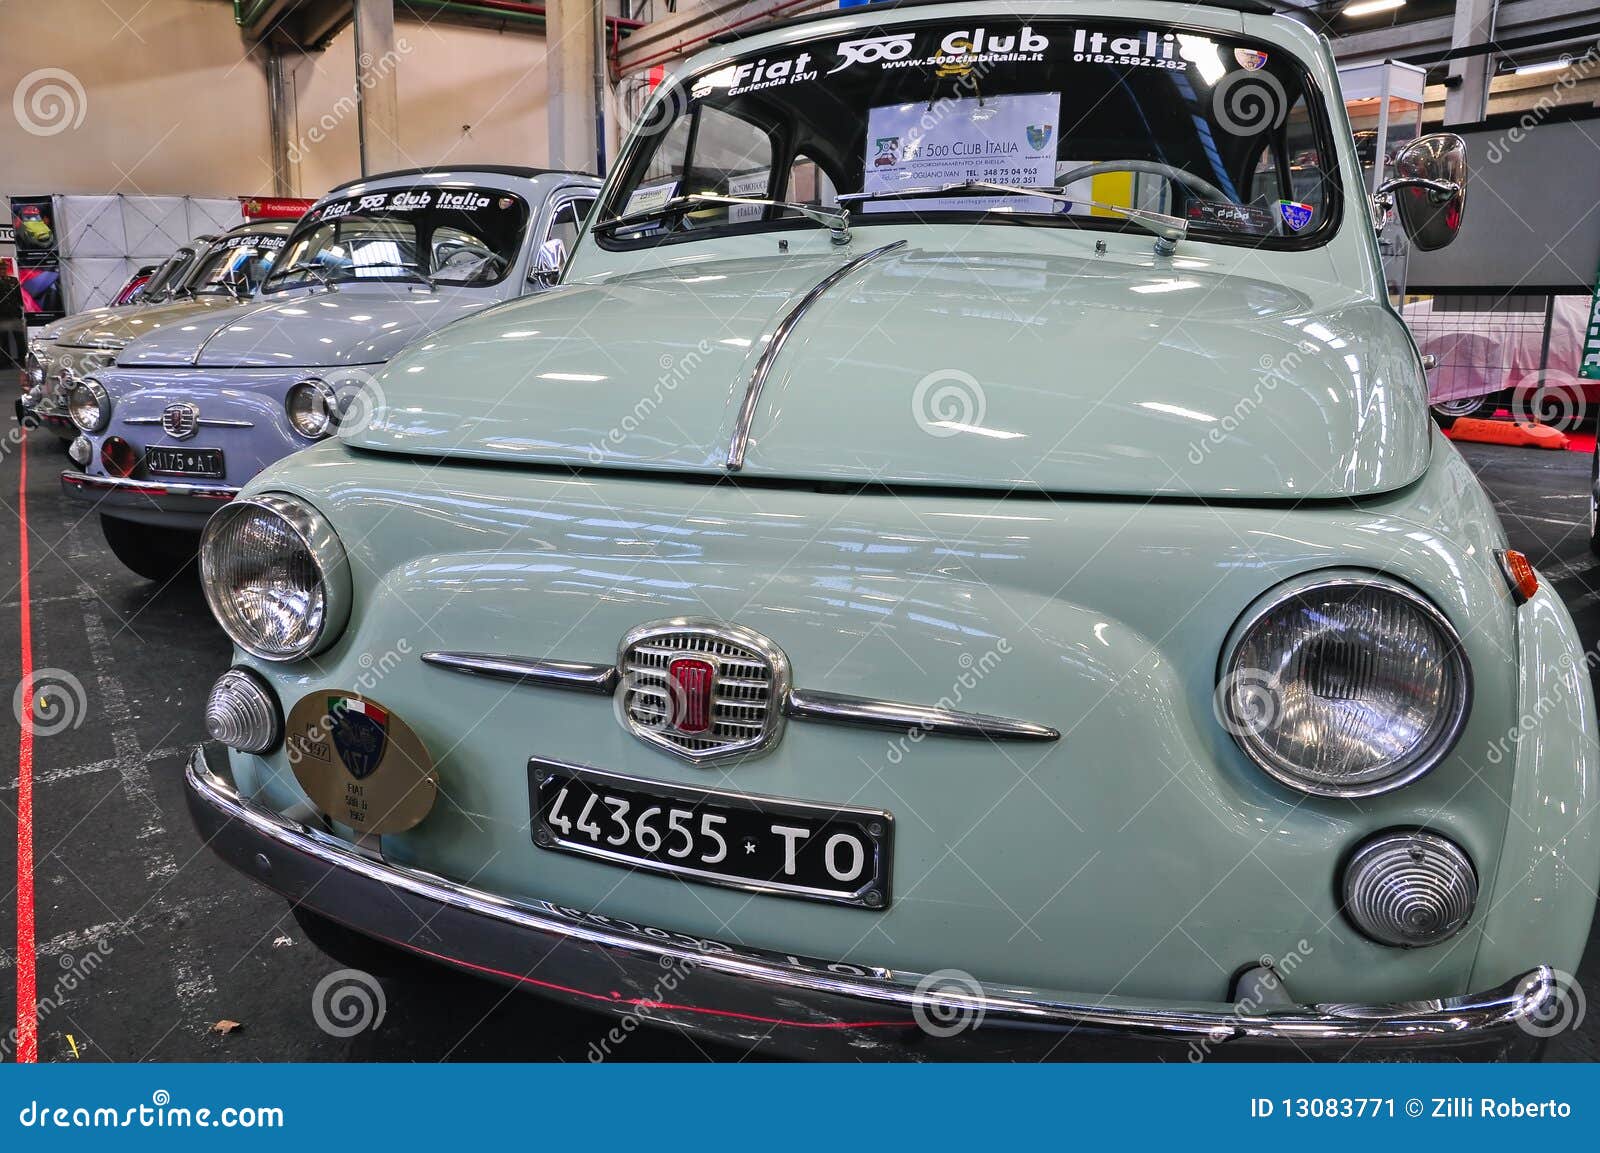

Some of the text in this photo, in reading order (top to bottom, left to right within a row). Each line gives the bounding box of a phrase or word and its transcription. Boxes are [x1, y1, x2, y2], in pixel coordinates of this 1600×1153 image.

[729, 27, 1178, 89] Fiat 500 Club Itali
[1073, 54, 1187, 71] 0182.582.282
[791, 70, 818, 85] (SV)
[926, 143, 949, 157] 500
[953, 141, 981, 155] CLUB
[985, 140, 1019, 155] ITALIA
[944, 170, 960, 178] IVAN
[966, 169, 979, 177] TEL.
[999, 168, 1009, 176] 75
[1024, 167, 1038, 175] 963
[1011, 176, 1021, 184] 62
[1023, 176, 1036, 184] 351
[353, 194, 388, 213] 500
[393, 191, 432, 206] Club
[437, 191, 491, 207] Italia
[548, 787, 865, 881] 443655 TO
